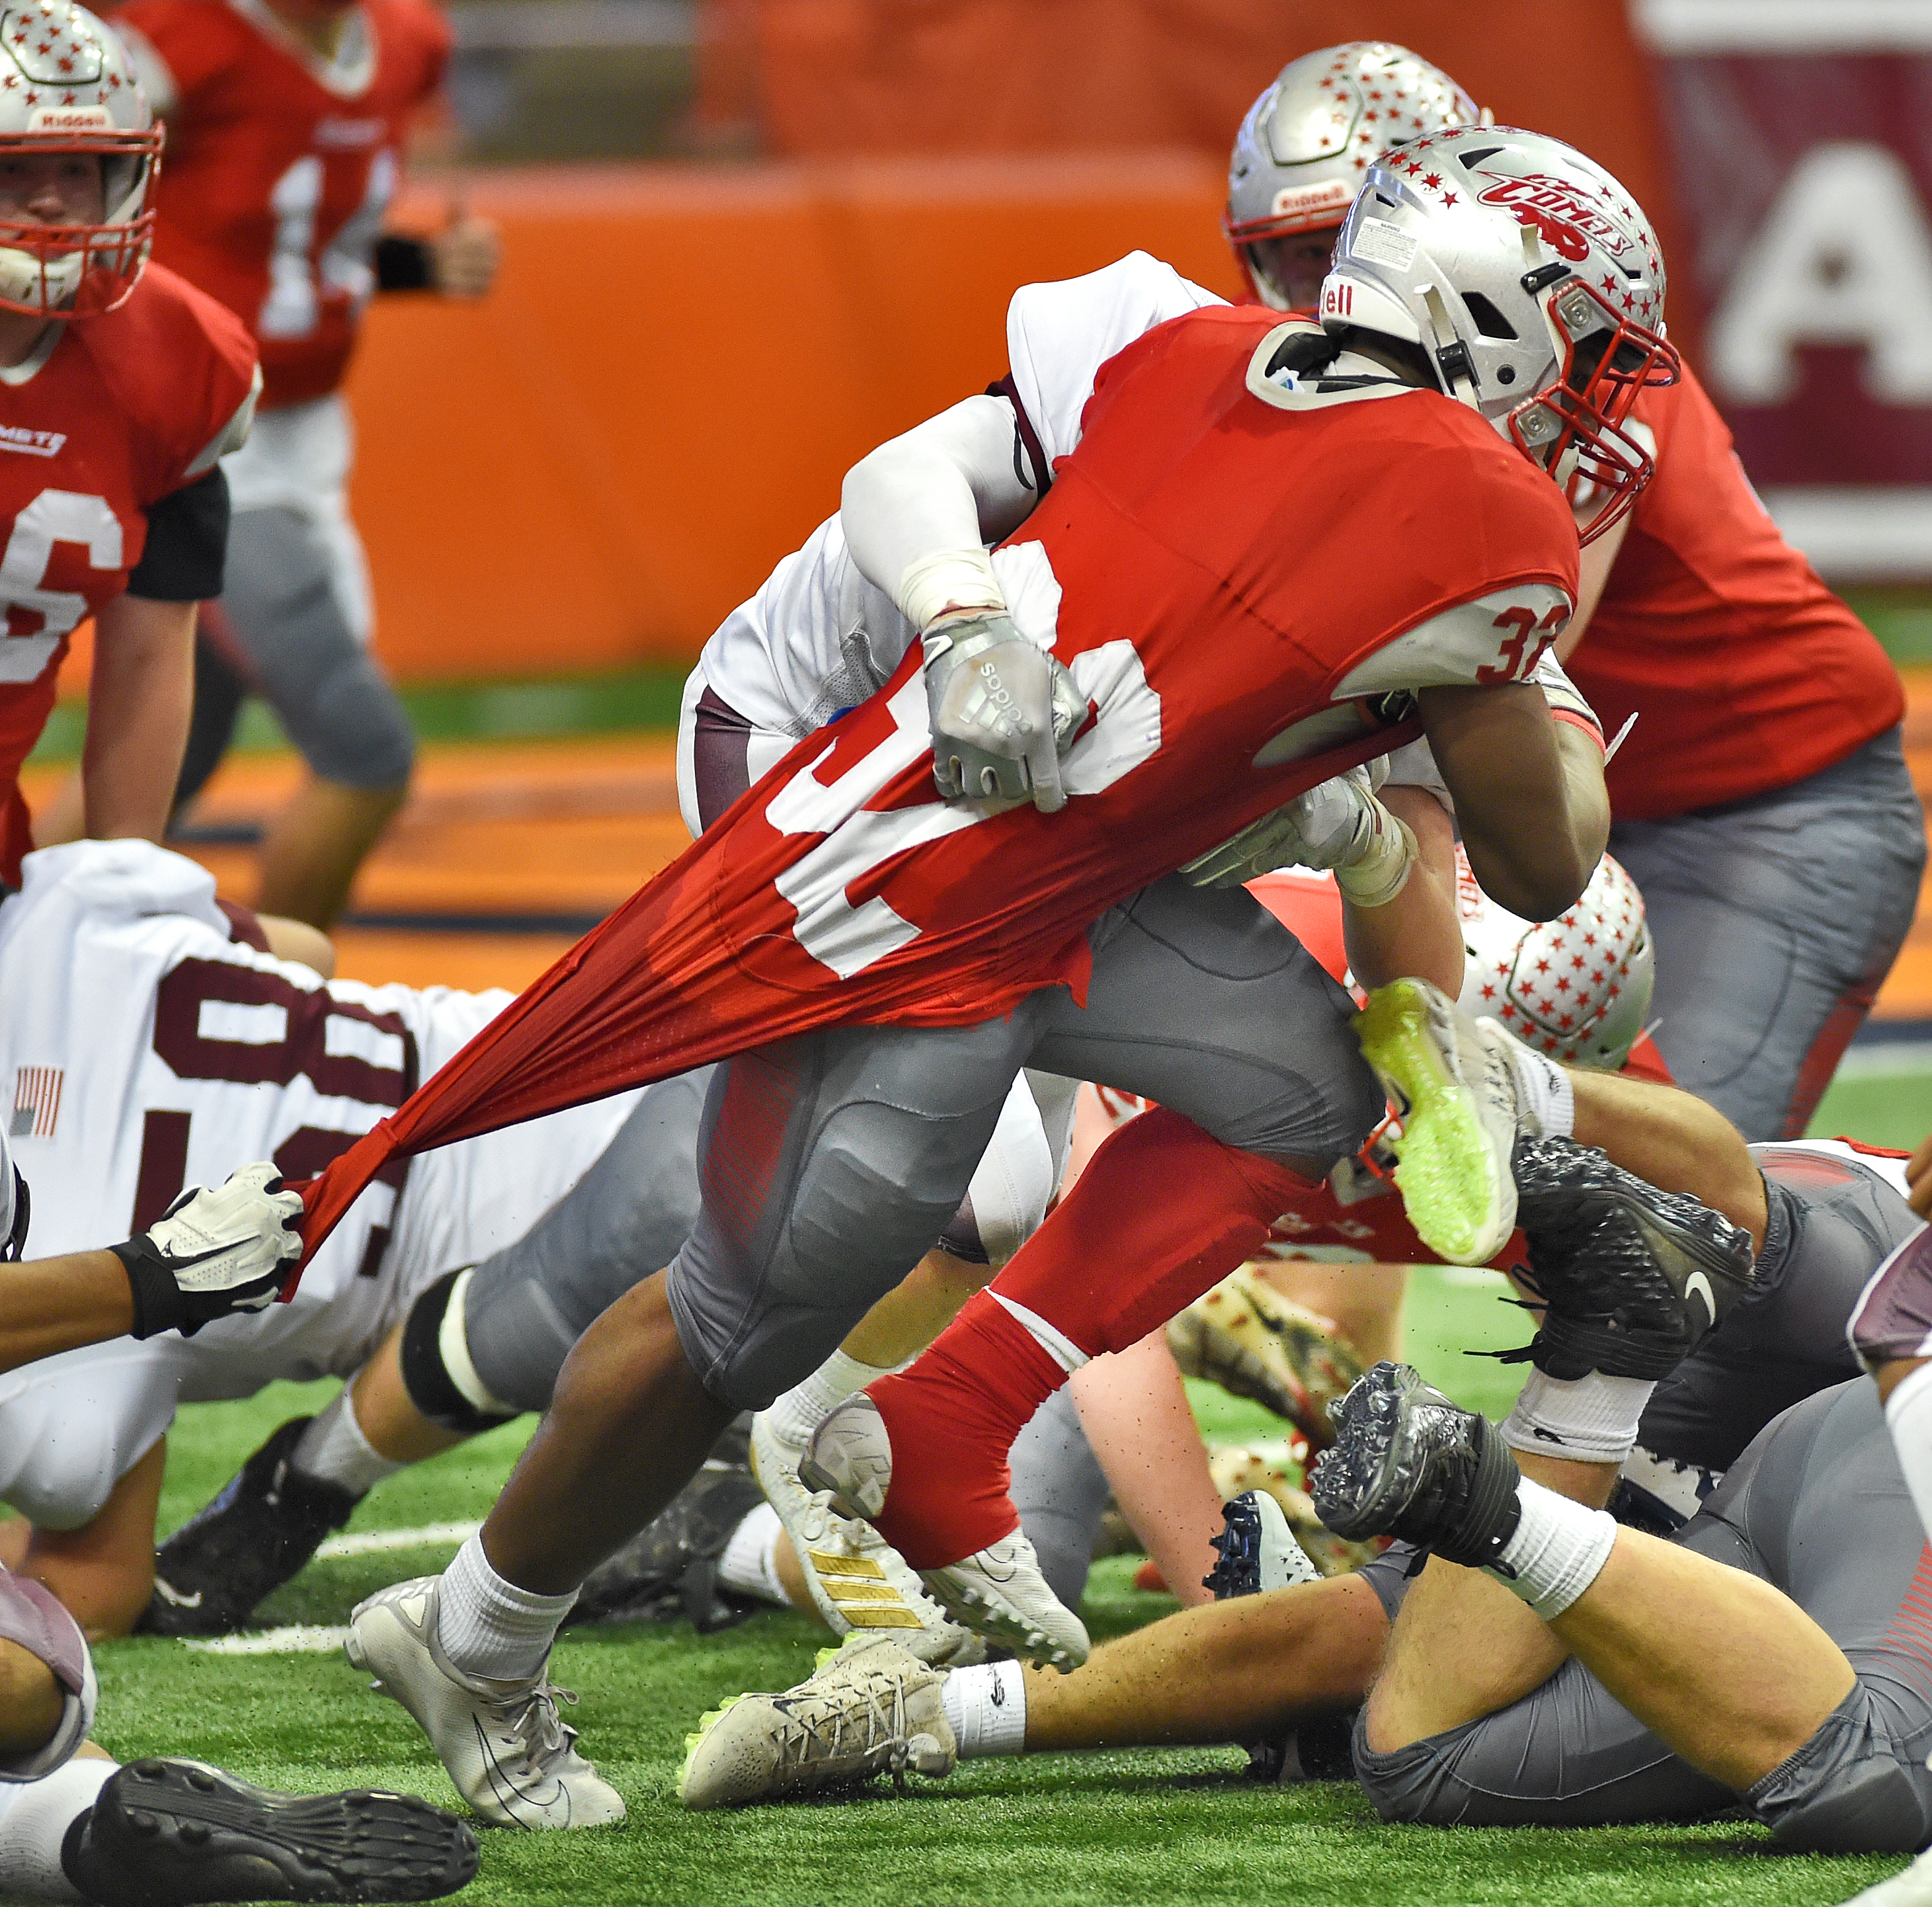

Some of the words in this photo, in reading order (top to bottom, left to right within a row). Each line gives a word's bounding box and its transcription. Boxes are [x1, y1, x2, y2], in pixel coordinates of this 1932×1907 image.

[1281, 184, 1345, 210] Riddell
[1323, 284, 1353, 315] ell
[1475, 604, 1570, 684] 32
[980, 662, 1033, 735] adidas
